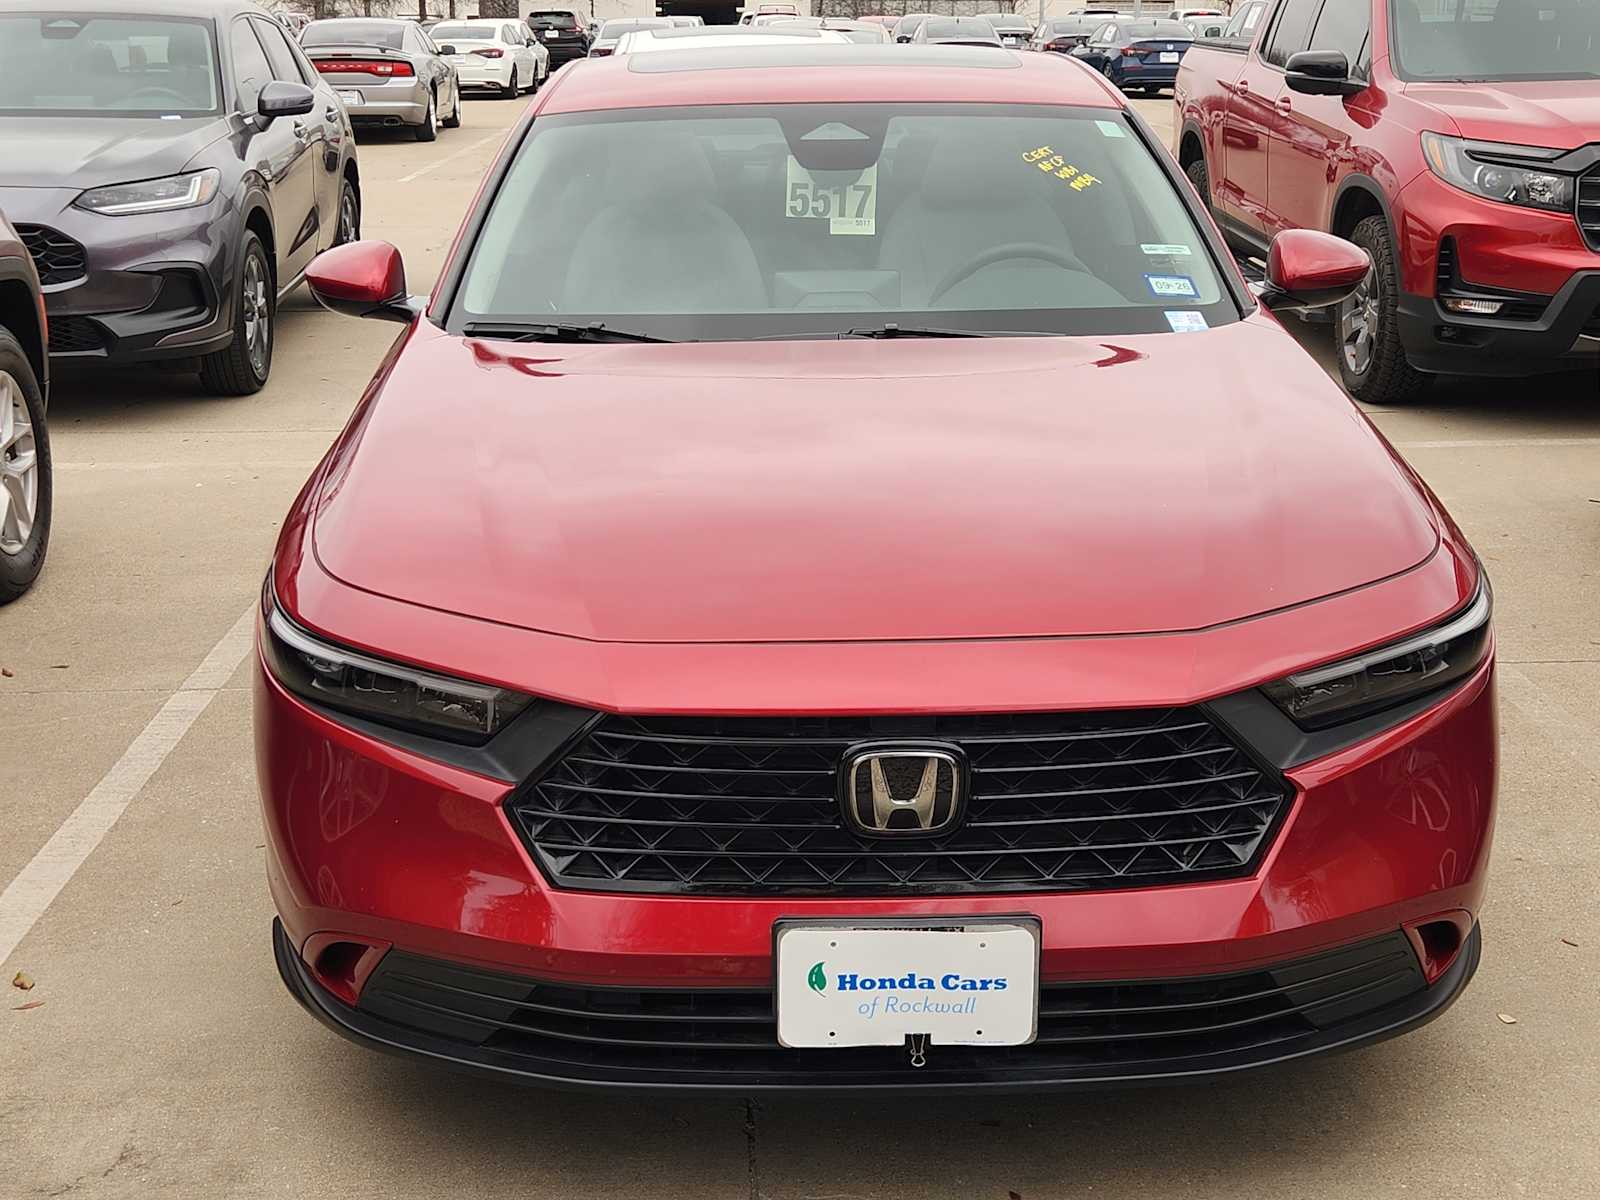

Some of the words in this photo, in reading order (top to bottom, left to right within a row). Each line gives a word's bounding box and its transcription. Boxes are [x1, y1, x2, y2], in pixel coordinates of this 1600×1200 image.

[789, 183, 872, 218] 5517
[837, 973, 936, 991] Honda
[941, 974, 1008, 991] Cars
[858, 996, 881, 1019] of
[885, 997, 977, 1014] Rockwall
